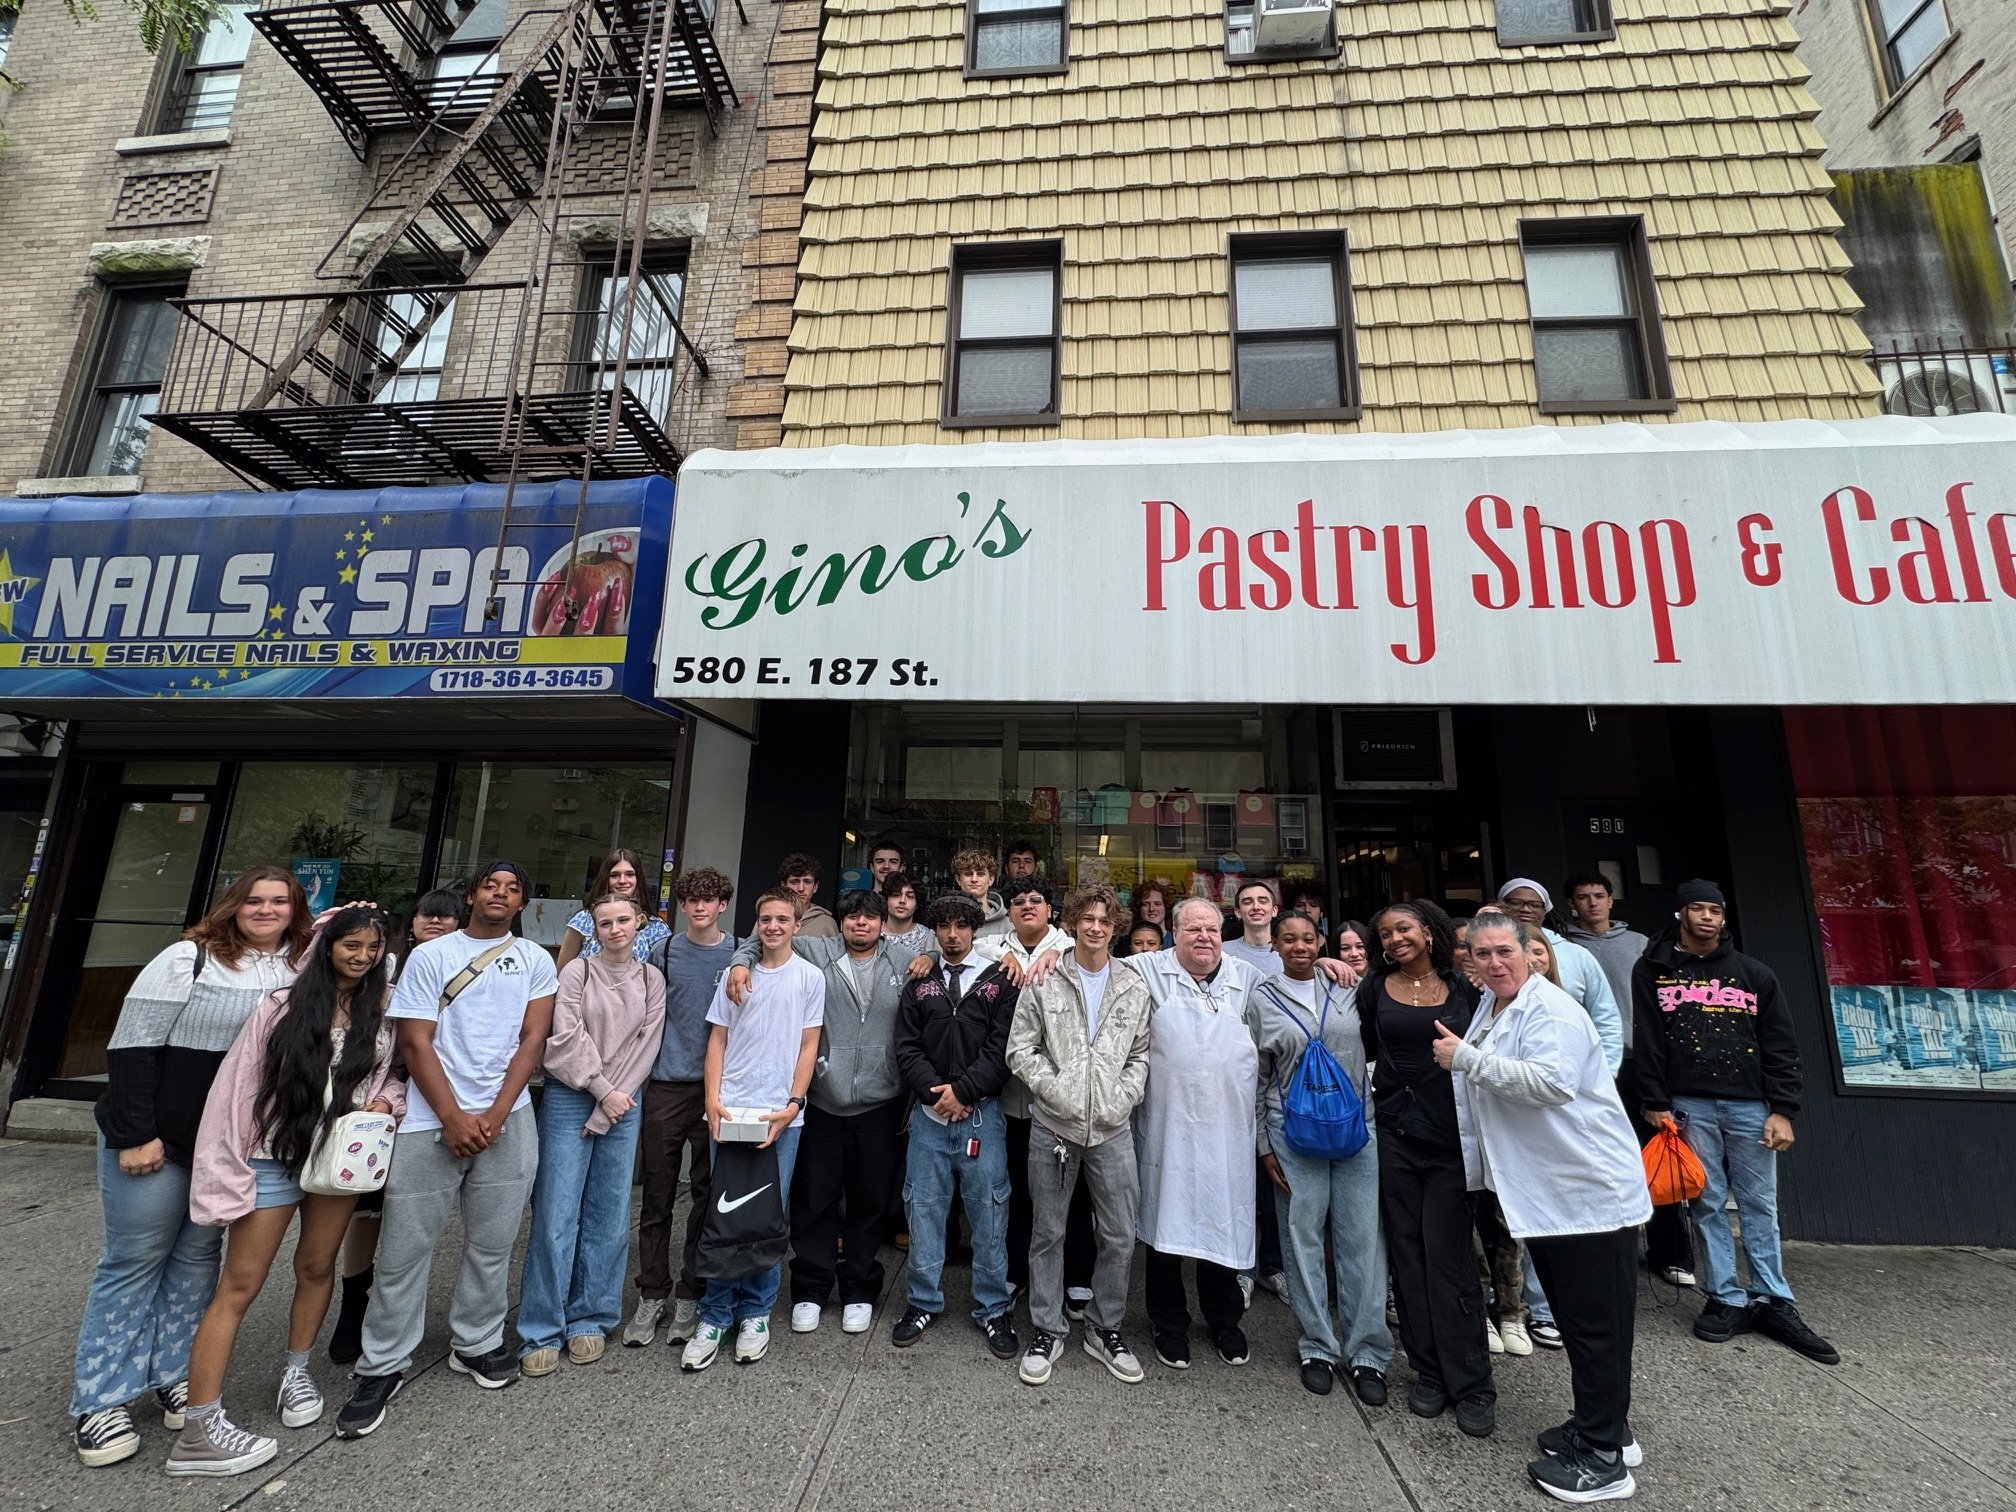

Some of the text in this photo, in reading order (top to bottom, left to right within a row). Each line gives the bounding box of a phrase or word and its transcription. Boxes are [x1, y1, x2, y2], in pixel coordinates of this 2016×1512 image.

[684, 491, 1032, 631] Gino's
[32, 546, 530, 637] NAILS & SPA
[1141, 499, 1436, 665] Pastry
[1465, 494, 1697, 664] Shop
[1737, 513, 1783, 587] &
[20, 640, 521, 665] FULL SERVICE NAILS & WAXING
[438, 669, 603, 689] 1718-364-3645
[672, 656, 939, 686] 580 E. 187 St.
[1590, 818, 1625, 833] 580
[298, 867, 318, 875] SHEN
[1841, 1002, 1878, 1030] BRONX
[1911, 1004, 1948, 1032] BRONX
[1984, 1005, 2016, 1033] BRON
[1850, 1026, 1880, 1049] TALE
